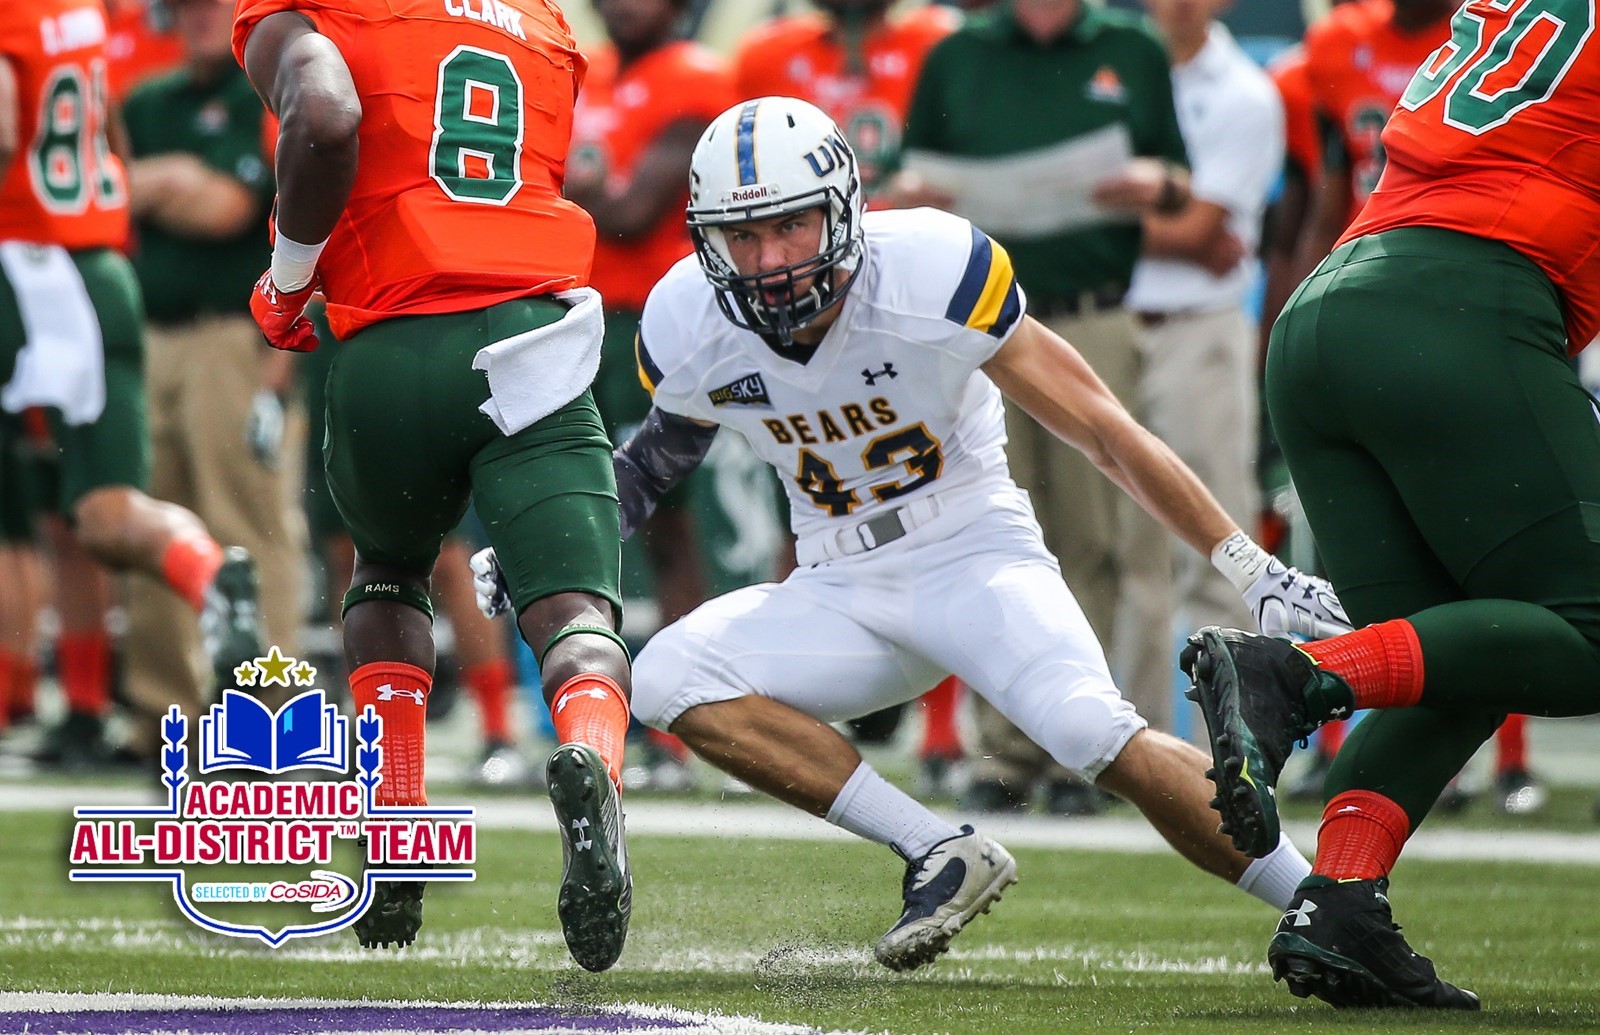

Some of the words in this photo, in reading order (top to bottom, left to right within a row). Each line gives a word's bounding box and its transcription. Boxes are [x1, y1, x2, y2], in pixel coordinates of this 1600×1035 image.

[443, 0, 527, 41] CLARK
[429, 44, 524, 207] 8
[732, 187, 768, 202] Riddell
[762, 396, 898, 444] BEARS
[794, 421, 944, 517] 43
[364, 583, 400, 593] RAMS
